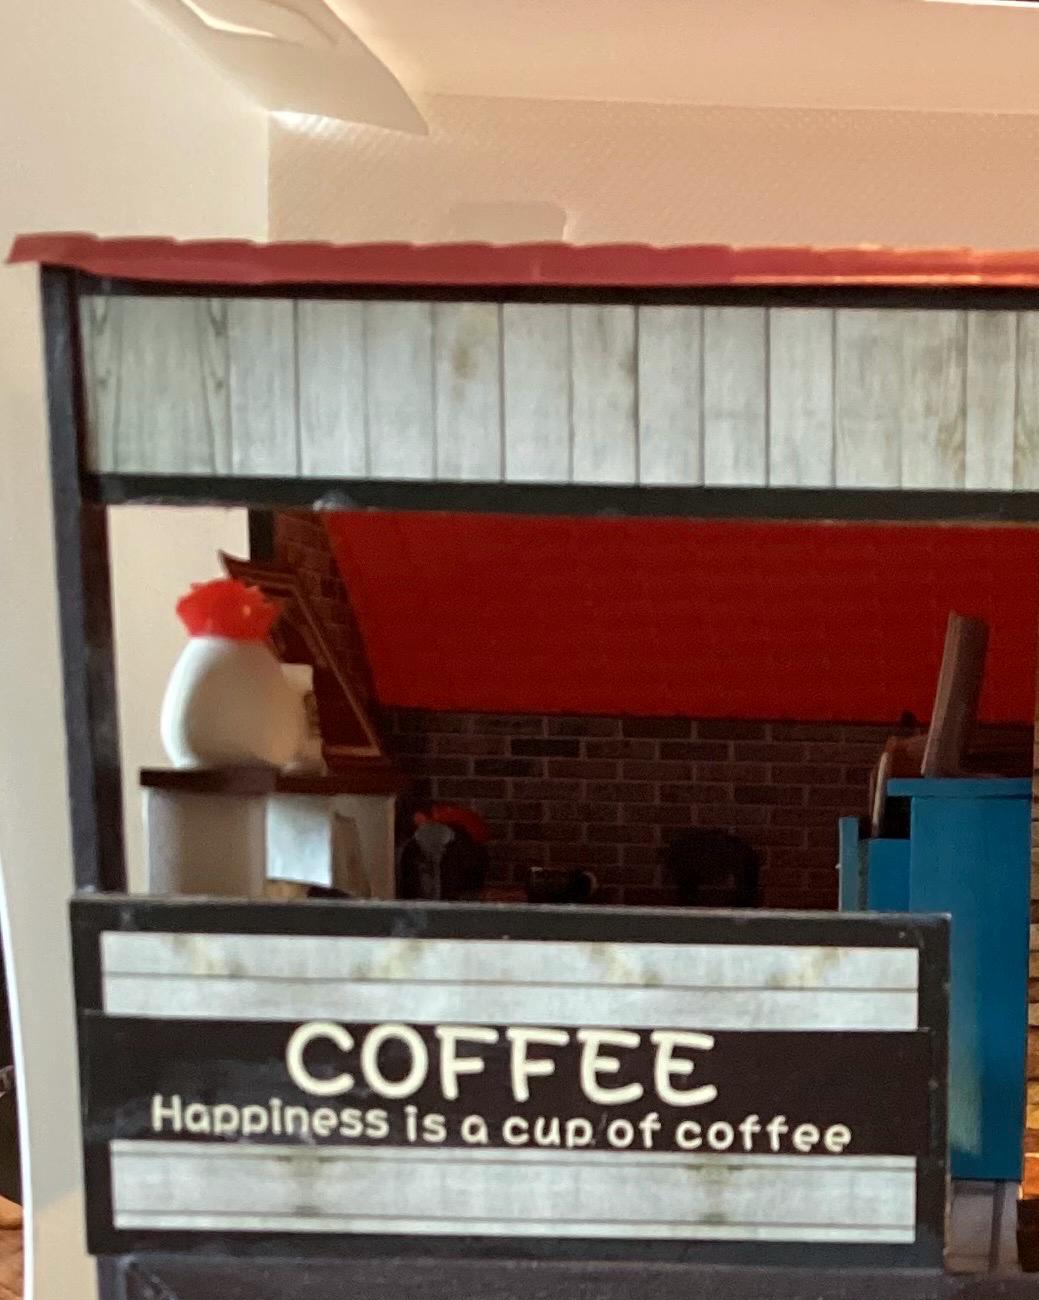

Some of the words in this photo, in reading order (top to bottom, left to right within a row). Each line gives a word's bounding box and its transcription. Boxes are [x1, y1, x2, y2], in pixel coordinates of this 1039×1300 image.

[285, 1020, 718, 1108] COFFEE
[151, 1093, 390, 1138] Happiness
[404, 1105, 448, 1144] is
[461, 1115, 489, 1144] a
[502, 1116, 595, 1149] cup
[607, 1112, 662, 1149] of
[675, 1114, 852, 1153] coffee
